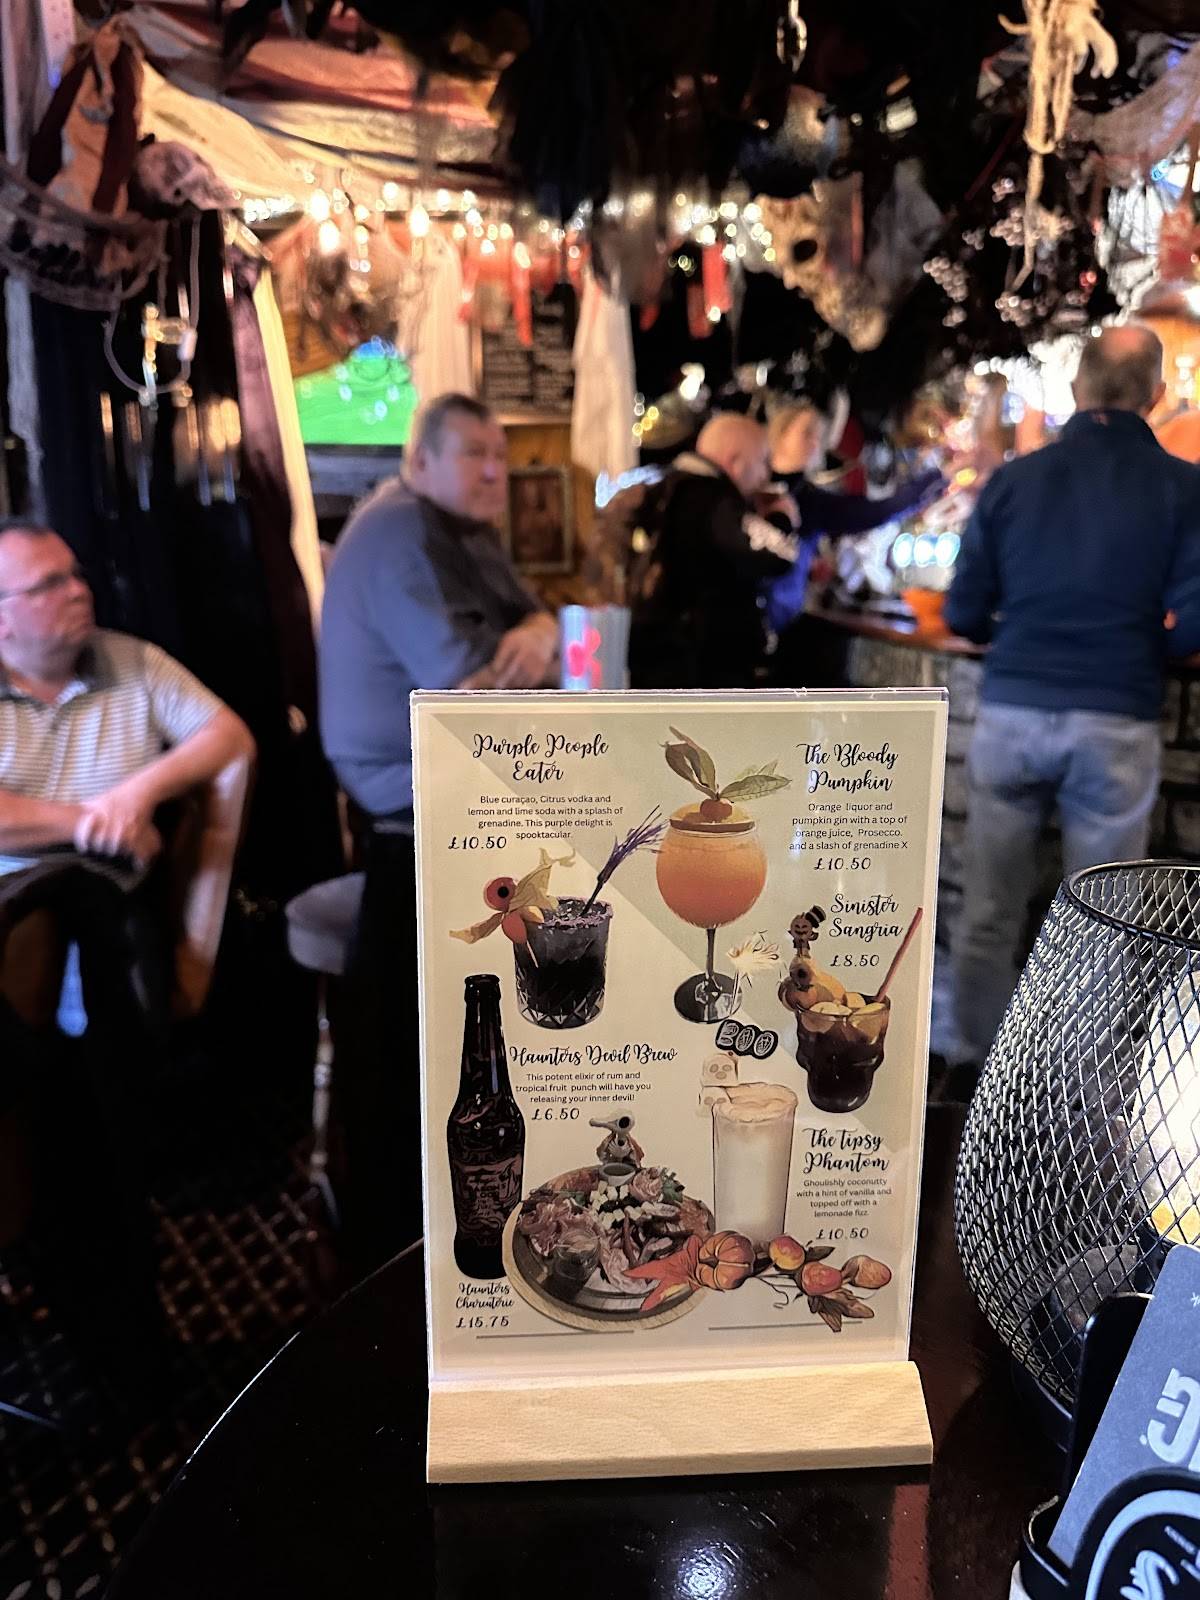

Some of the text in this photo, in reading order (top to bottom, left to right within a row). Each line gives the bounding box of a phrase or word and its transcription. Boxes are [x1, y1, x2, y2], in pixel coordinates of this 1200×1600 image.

[472, 733, 609, 758] Purple People
[796, 743, 899, 770] The Bloody
[512, 760, 564, 783] Eater
[808, 769, 893, 794] Pumpkin
[480, 796, 499, 804] Blue
[540, 795, 565, 804] Citrus
[567, 795, 593, 803] vodka
[595, 795, 611, 803] and
[468, 808, 495, 816] lemon
[497, 808, 513, 816] and
[585, 807, 612, 816] splash
[614, 807, 624, 815] of
[808, 803, 842, 813] Orange
[875, 803, 893, 811] and
[478, 820, 524, 829] grenadine.
[545, 819, 573, 829] purple
[574, 819, 603, 828] delight
[792, 816, 832, 826] pumpkin
[833, 816, 848, 826] gin
[850, 816, 870, 824] with
[880, 817, 896, 825] top
[898, 816, 908, 824] of
[516, 831, 573, 840] spooktacular.
[795, 829, 827, 839] orange
[828, 829, 853, 839] juice,
[448, 836, 507, 850] £10.50
[789, 842, 807, 850] and
[816, 842, 840, 850] slash
[853, 841, 899, 851] grenadine
[814, 858, 872, 871] £10.50
[830, 893, 899, 916] Sinister
[829, 918, 904, 943] Sangria
[830, 954, 881, 967] £8.50
[716, 1021, 776, 1058] BOO
[509, 1044, 678, 1067] Haunters Devil Brew
[526, 1073, 544, 1081] This
[545, 1073, 573, 1082] potent
[574, 1072, 595, 1080] elixir
[516, 1085, 547, 1093] tropical
[549, 1084, 567, 1092] fruit
[571, 1084, 597, 1092] punch
[598, 1083, 613, 1091] will
[636, 1084, 651, 1092] you
[530, 1096, 567, 1104] releasing
[569, 1096, 588, 1104] your
[531, 1108, 580, 1121] £6.50
[802, 1128, 836, 1148] The
[803, 1152, 890, 1174] Phantom
[803, 1178, 888, 1188] Ghoulishly coconutty
[810, 1200, 839, 1208] topped
[816, 1228, 869, 1240] £10.50
[459, 1282, 511, 1296] Haunters
[456, 1316, 509, 1329] £15.75
